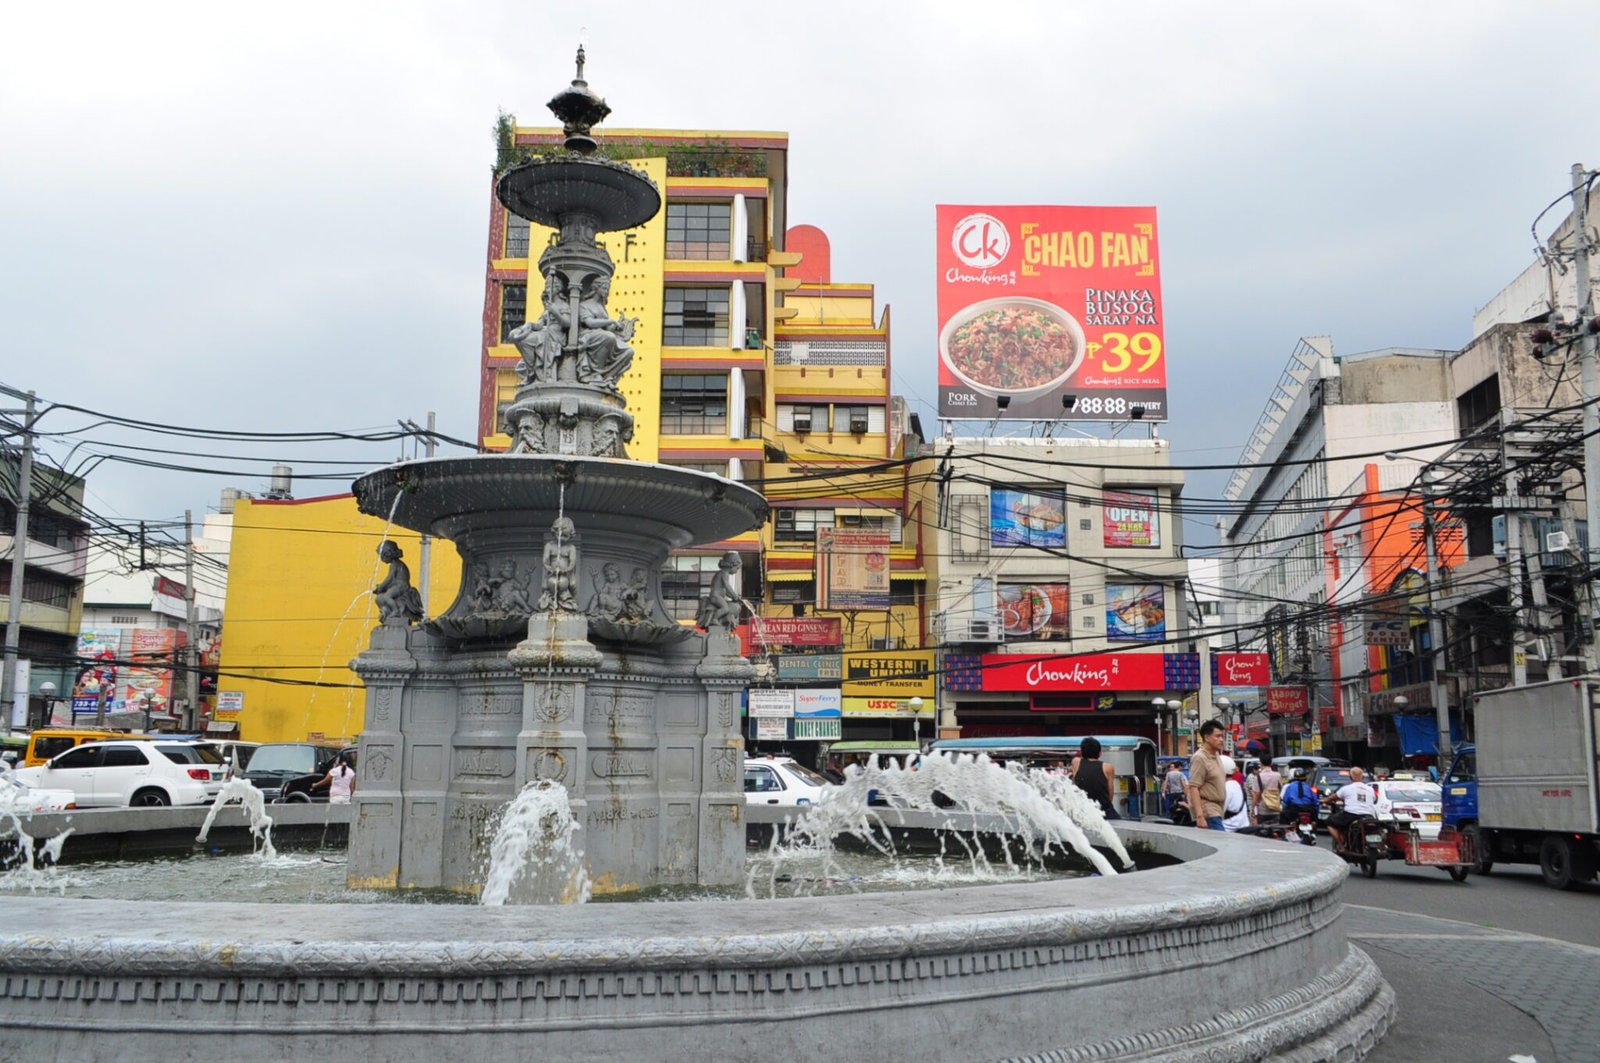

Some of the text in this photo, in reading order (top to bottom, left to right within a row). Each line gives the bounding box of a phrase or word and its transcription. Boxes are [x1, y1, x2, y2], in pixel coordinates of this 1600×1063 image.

[958, 222, 1002, 260] Ck
[1025, 231, 1149, 268] CHAO FAN
[946, 268, 1008, 285] Chowking
[1085, 288, 1153, 301] PINAKA
[1085, 301, 1155, 315] BUSOG
[1086, 315, 1157, 325] SARAP NA
[948, 392, 977, 402] PORK
[1110, 507, 1149, 522] OPEN
[782, 623, 797, 633] RED
[797, 623, 828, 633] GINSENG
[780, 660, 840, 669] DENTAL CLINIC
[850, 659, 913, 669] WESTERN
[1026, 661, 1109, 687] Chowking
[1271, 689, 1301, 700] Happy
[868, 700, 897, 709] USSC
